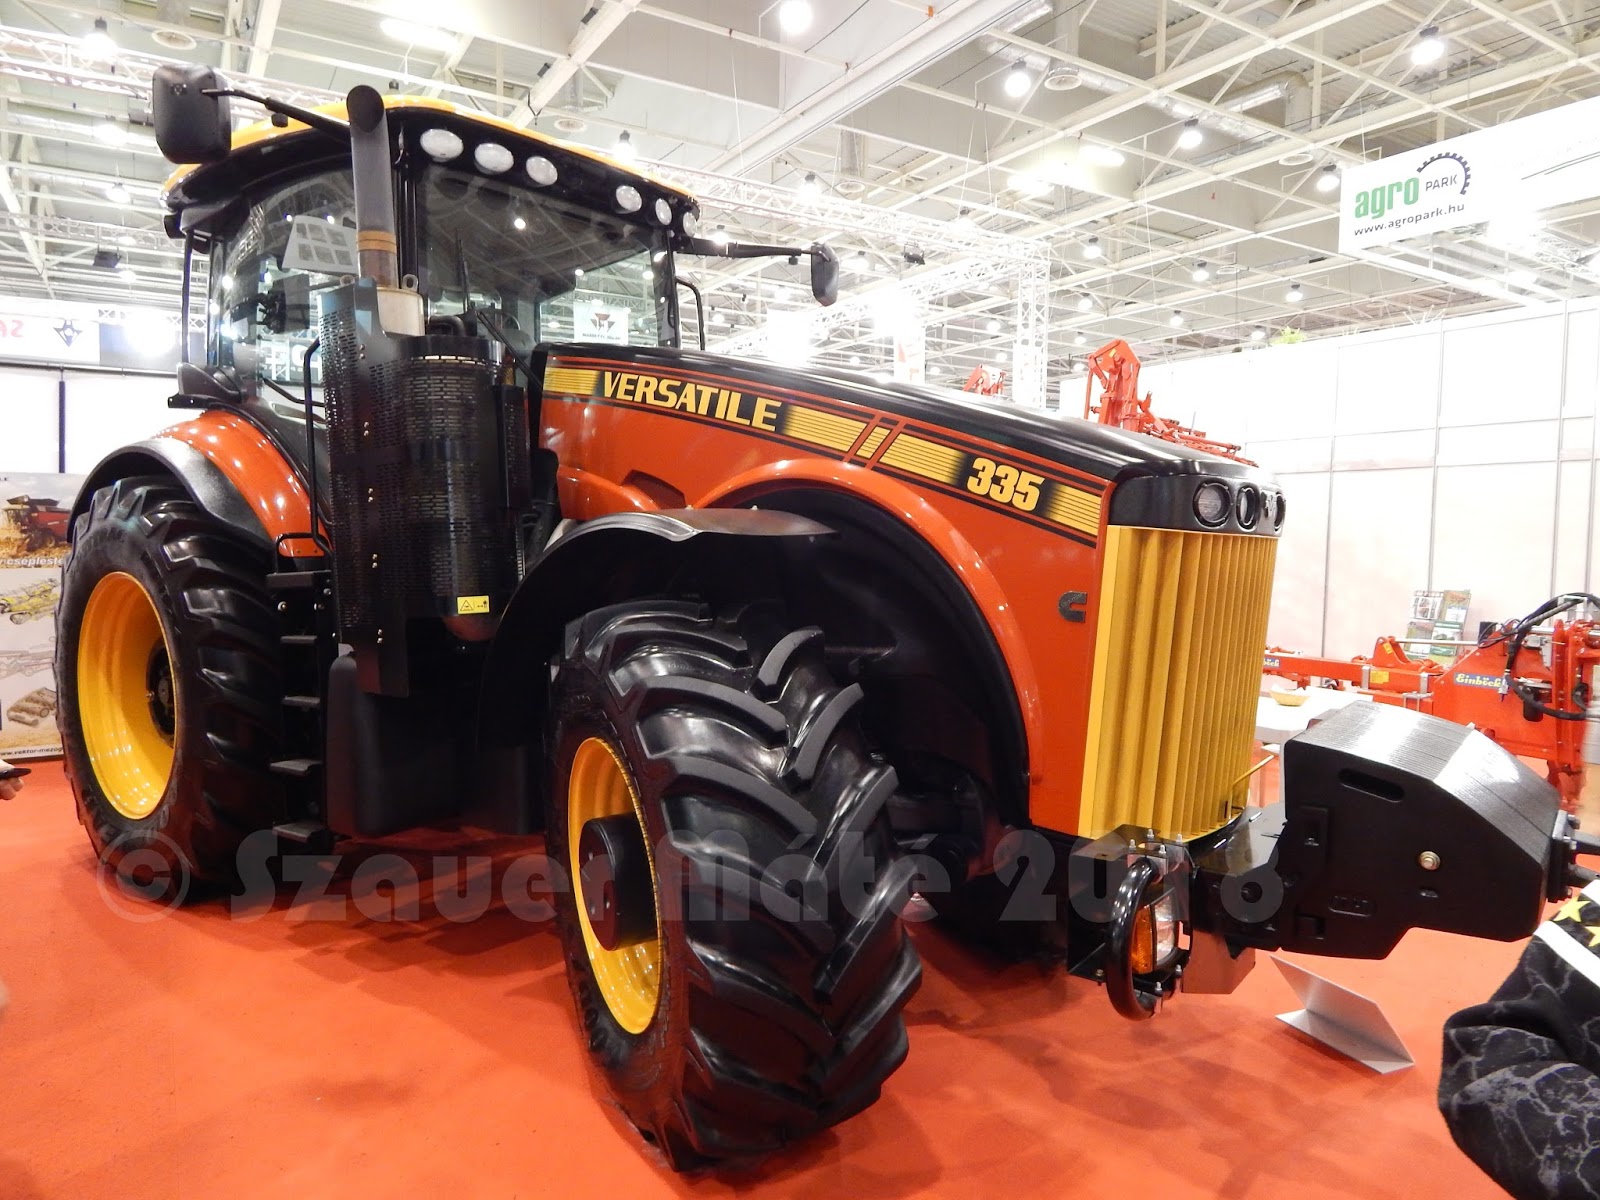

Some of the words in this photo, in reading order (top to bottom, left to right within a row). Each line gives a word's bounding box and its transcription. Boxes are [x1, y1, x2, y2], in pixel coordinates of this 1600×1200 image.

[1355, 177, 1420, 219] agro
[1425, 174, 1458, 191] PARK
[1354, 203, 1465, 236] www.agropark.hu
[602, 370, 782, 433] VERSATILE
[966, 457, 1045, 512] 335
[1455, 672, 1502, 688] Einböck
